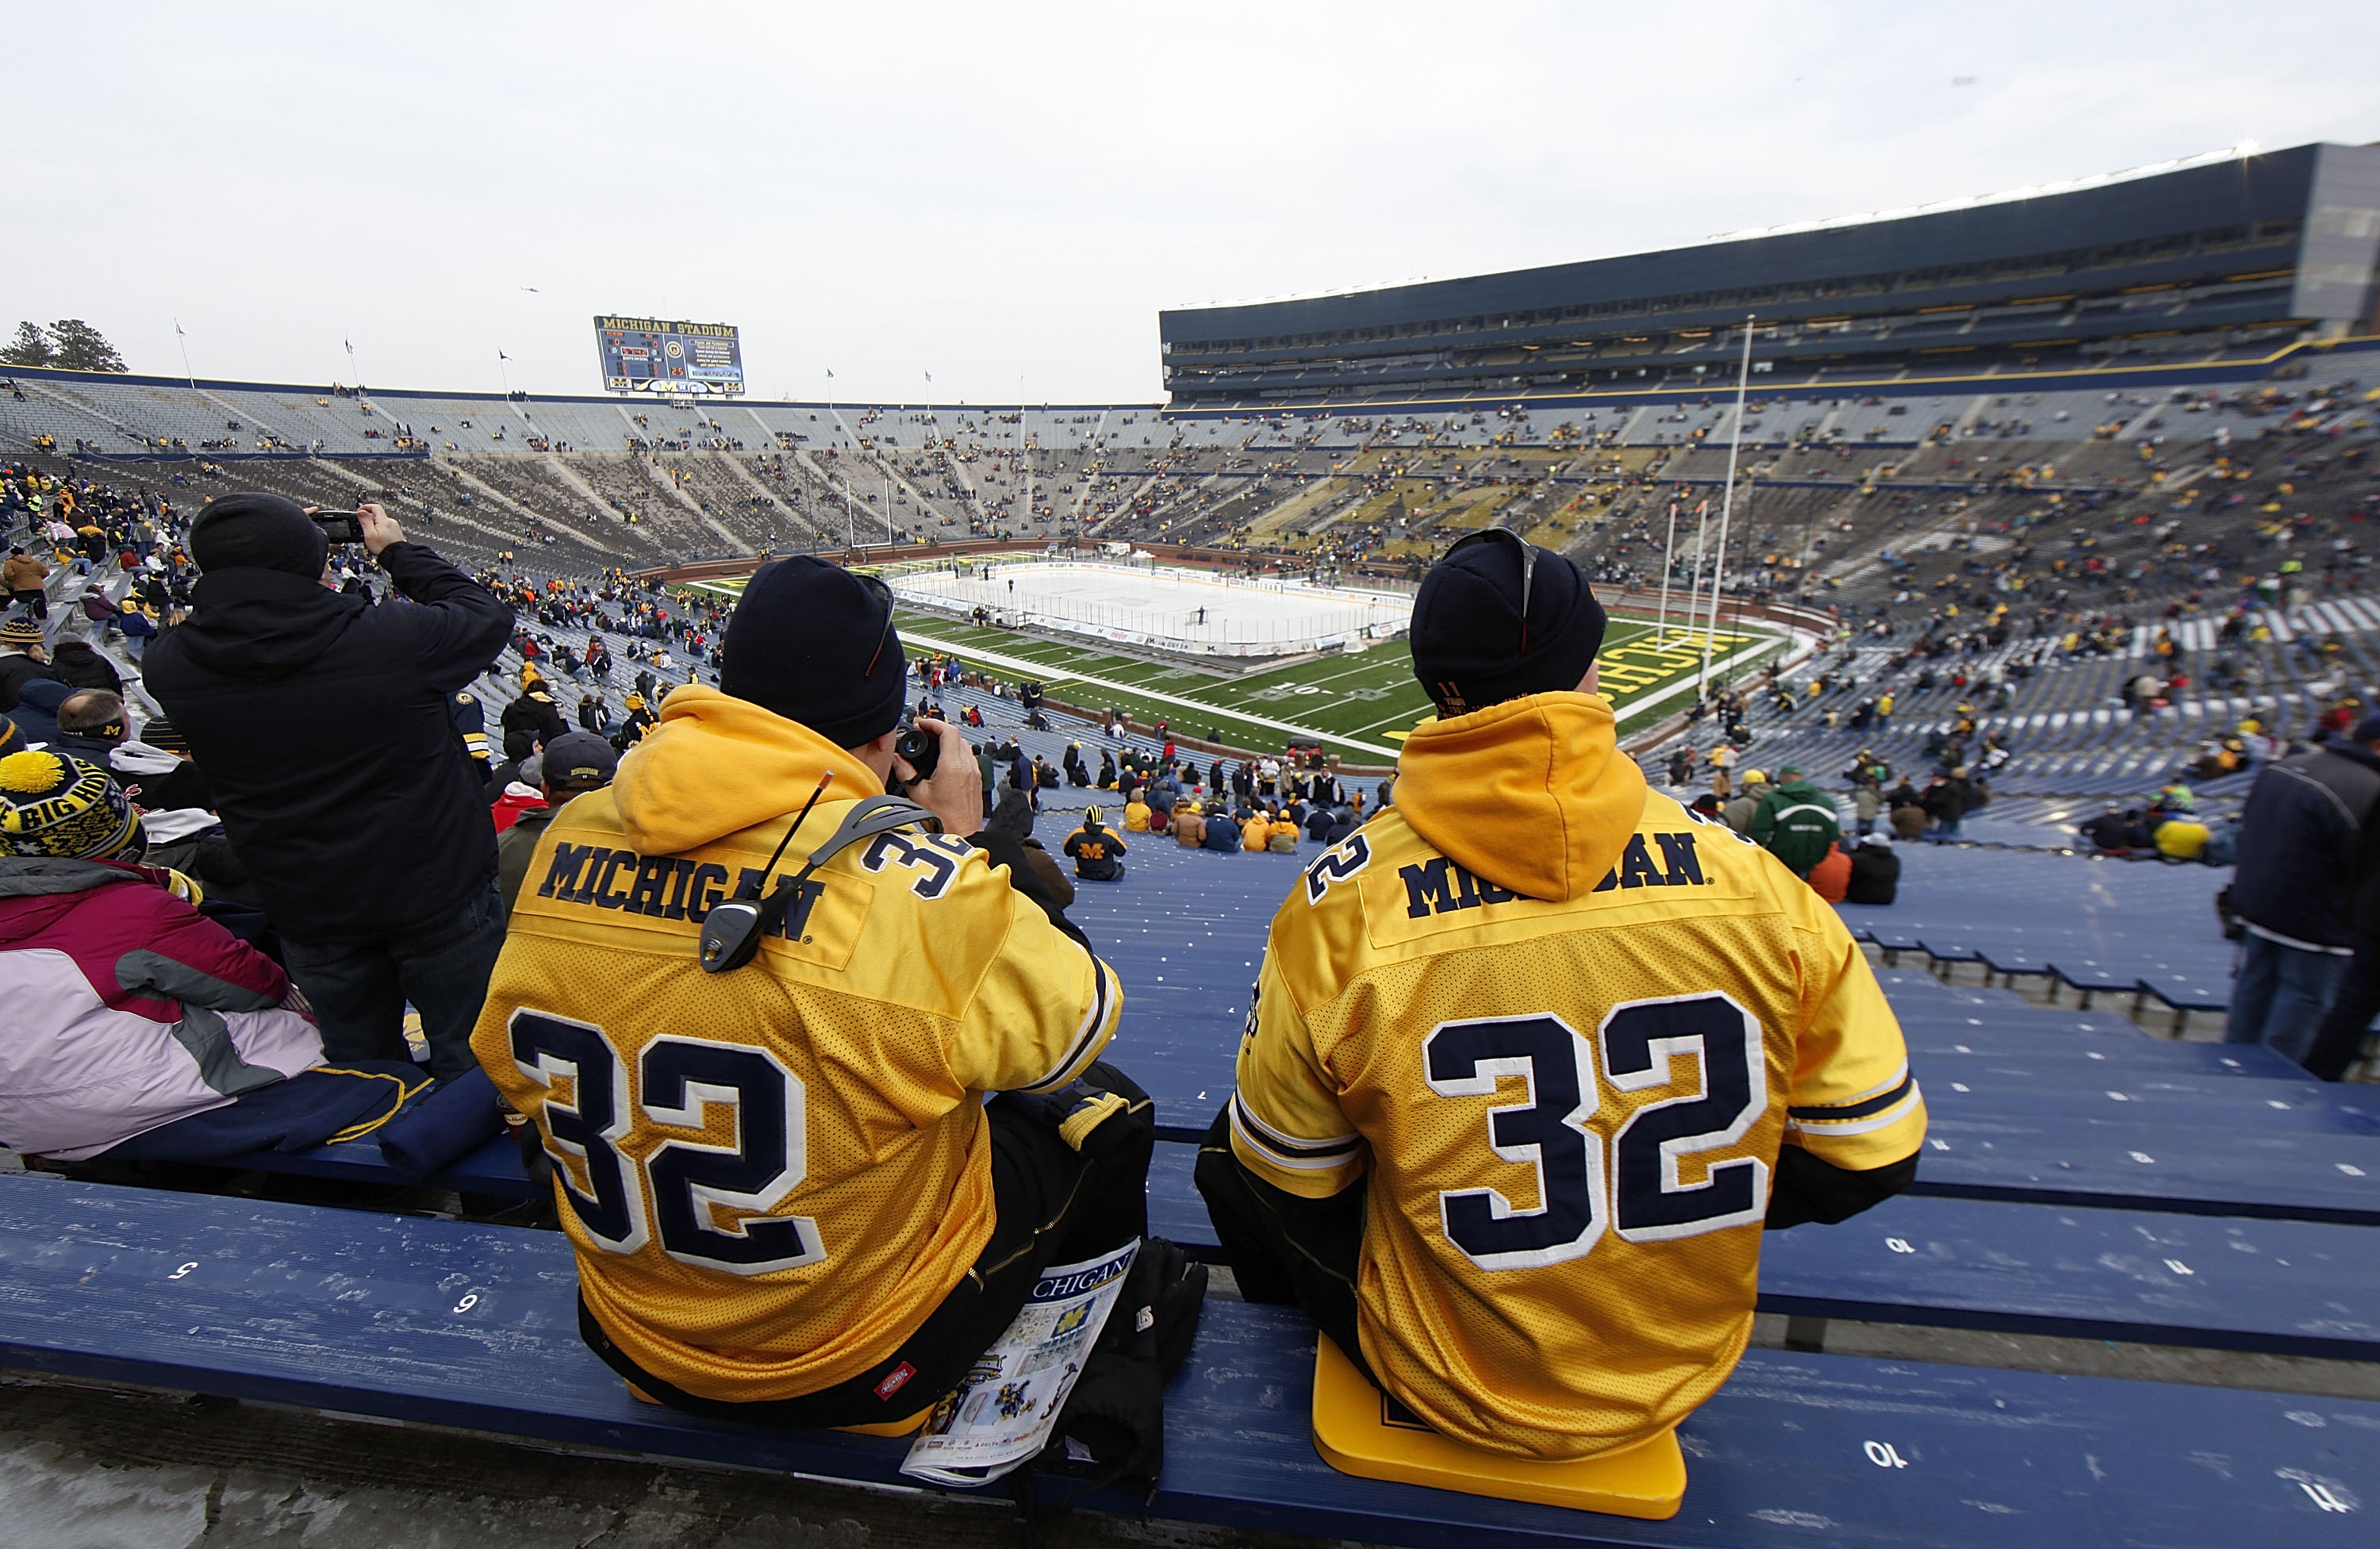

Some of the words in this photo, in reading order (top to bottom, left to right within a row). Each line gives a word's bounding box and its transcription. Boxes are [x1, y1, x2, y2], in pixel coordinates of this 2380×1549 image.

[603, 317, 670, 332] MICHIGAN
[678, 323, 734, 337] STADIUM
[660, 380, 677, 392] M
[1241, 578, 1278, 591] MICHIGAN
[1110, 632, 1128, 641] meijer
[103, 725, 121, 736] M
[18, 798, 78, 831] BIG
[1078, 843, 1105, 859] M
[1398, 832, 1705, 919] MIAN
[507, 1005, 827, 1276] 32
[1421, 989, 1769, 1271] 32
[1885, 1237, 1915, 1253] 10
[2163, 1259, 2194, 1275] 11
[167, 1262, 198, 1279] 5
[1033, 1254, 1130, 1298] CHIGAN
[1864, 1441, 1908, 1469] 10
[2300, 1483, 2350, 1513] 11
